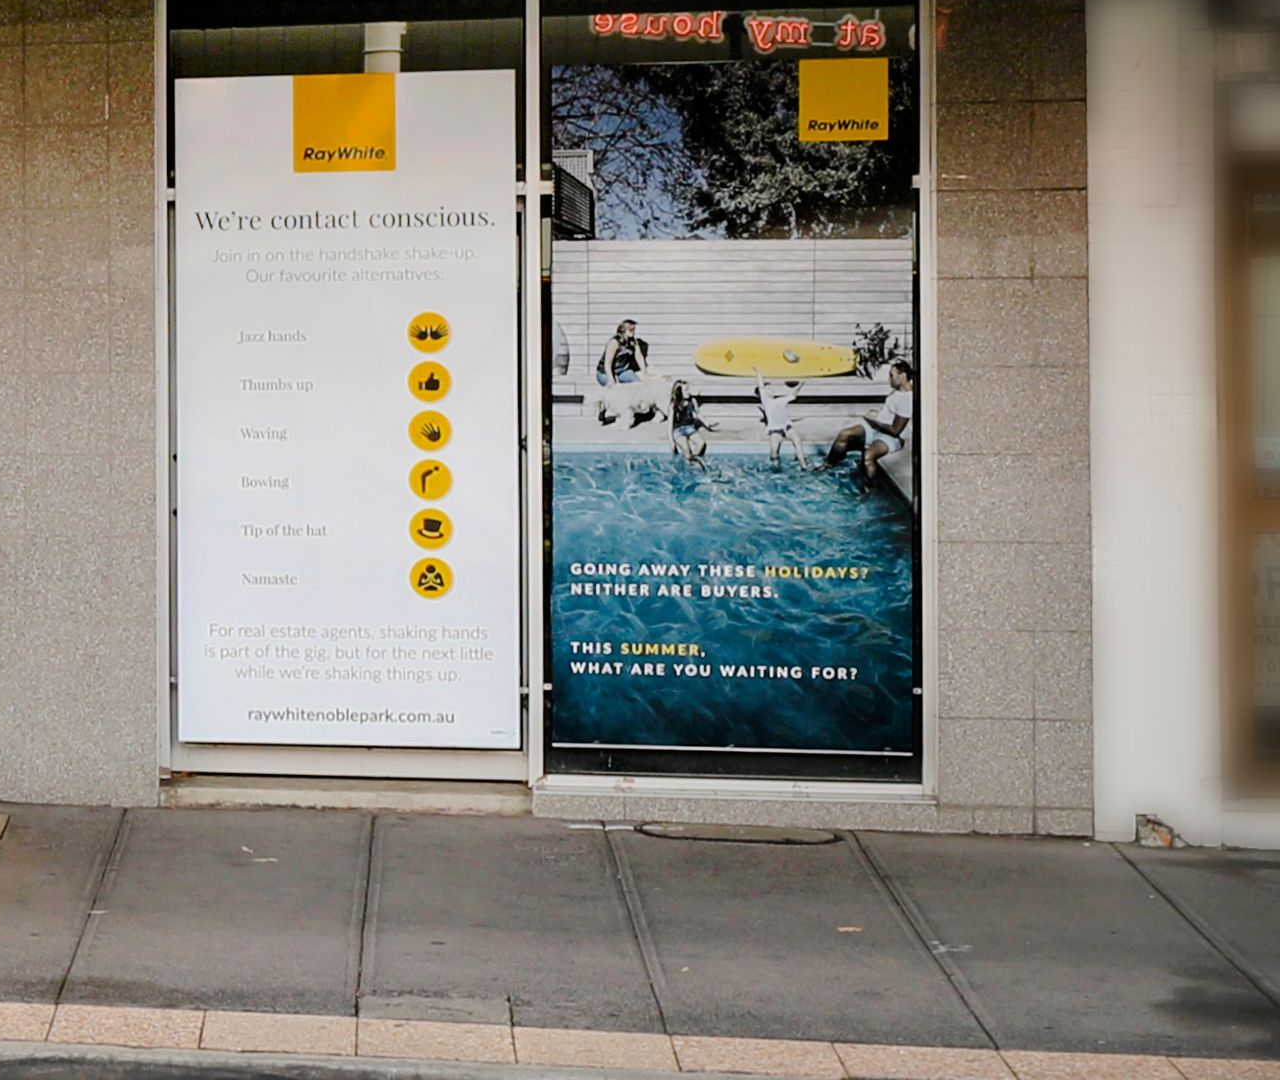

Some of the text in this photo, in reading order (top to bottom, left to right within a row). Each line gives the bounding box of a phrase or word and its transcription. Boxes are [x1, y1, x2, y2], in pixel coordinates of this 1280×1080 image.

[196, 207, 494, 230] We're contact conscious.
[213, 246, 477, 262] Join in on the handshake shake-up.
[246, 268, 444, 283] Our favourite alternatives:
[238, 330, 306, 344] Jazz hands
[240, 379, 313, 392] Thumbs up
[241, 427, 287, 441] Waving
[242, 476, 289, 489] Bowing
[241, 524, 326, 538] Tip of the hat
[243, 573, 297, 584] Namaste
[571, 563, 868, 581] GOING AWAY THESE HOLIDAYS?
[571, 583, 778, 598] NEITHER ARE BUYERS.
[210, 623, 488, 642] For real estate agents, shaking hands
[204, 644, 215, 658] is
[220, 646, 249, 660] part
[255, 644, 270, 658] of
[275, 645, 299, 658] the
[336, 646, 360, 659] but
[366, 646, 387, 659] for
[392, 646, 416, 660] the
[423, 648, 454, 660] next
[461, 646, 493, 660] little
[571, 642, 705, 657] THIS SUMMER,
[235, 665, 461, 683] while we're shaking things up.
[571, 662, 857, 679] WHAT ARE YOU WAITING FOR?
[248, 708, 454, 724] raywhitenoblepark.com.au
